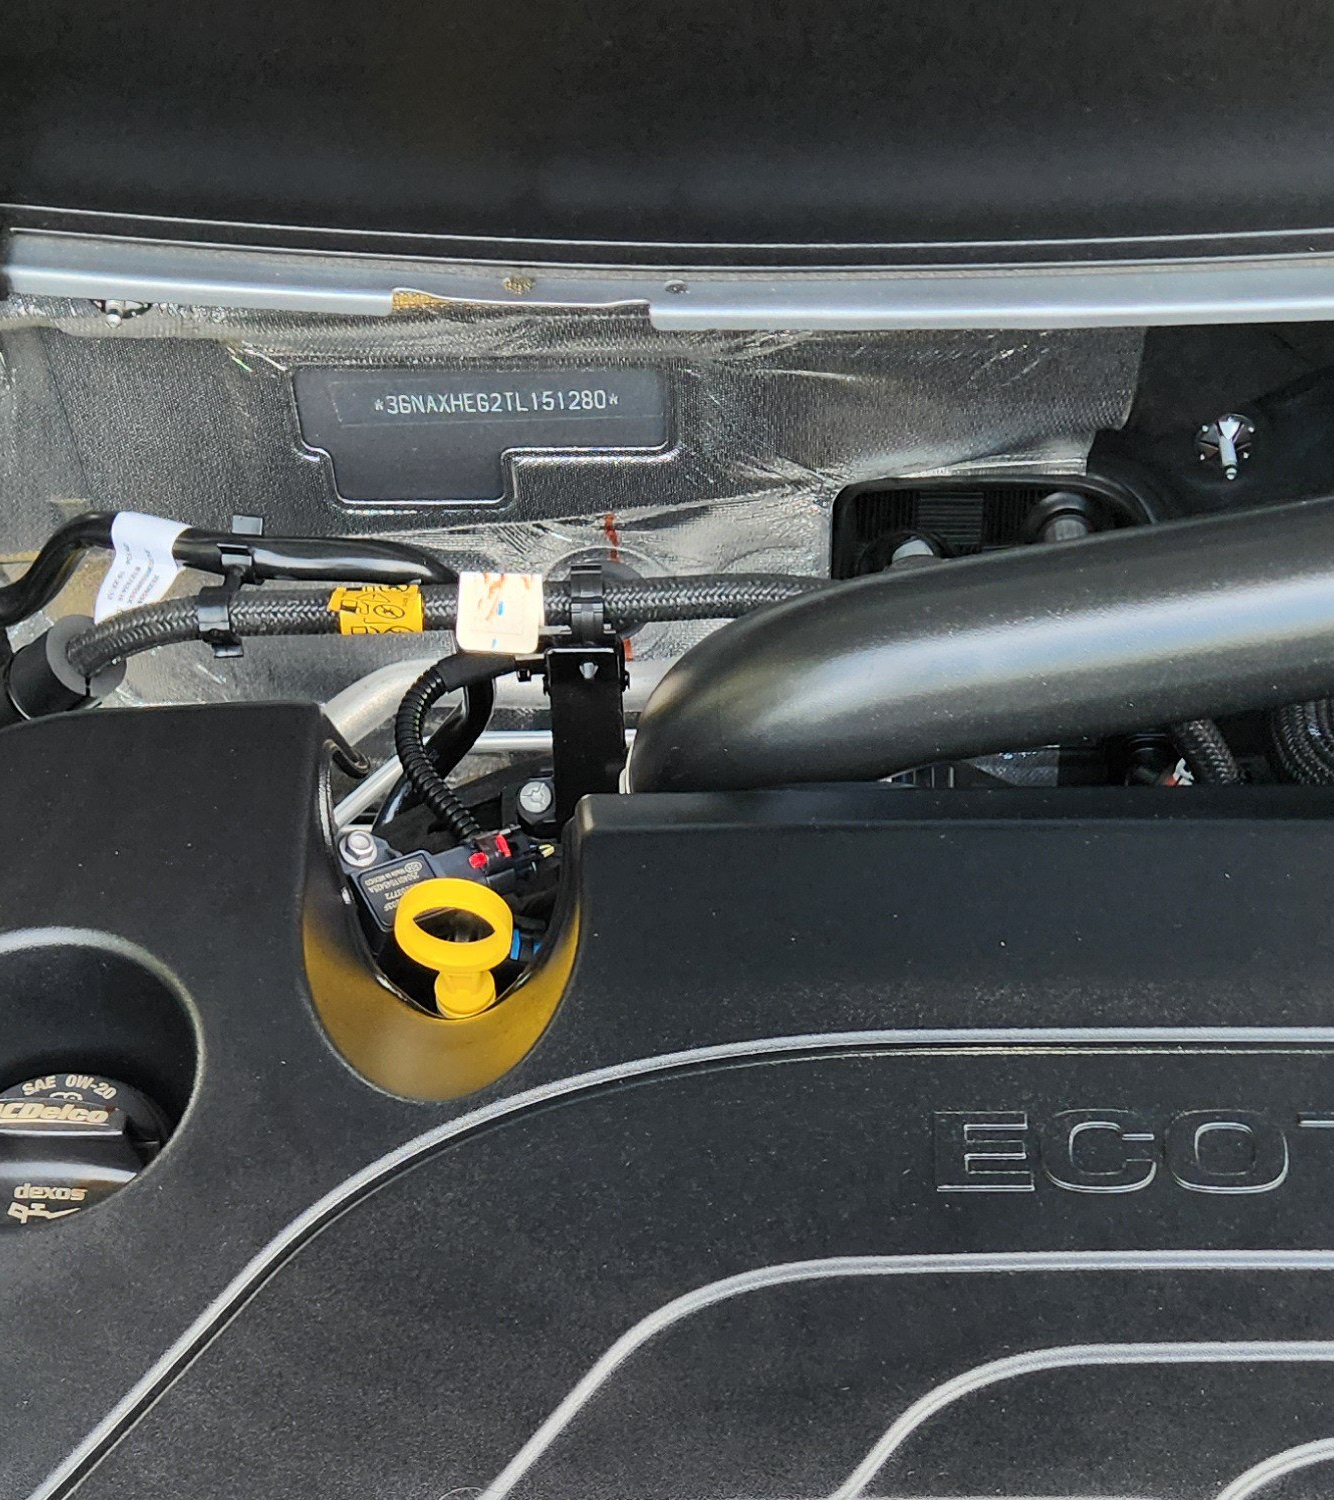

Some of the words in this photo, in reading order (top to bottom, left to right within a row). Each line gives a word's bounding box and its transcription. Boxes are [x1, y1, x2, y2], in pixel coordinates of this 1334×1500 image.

[22, 1075, 56, 1096] SAE
[65, 1074, 117, 1100] 0W-20
[13, 1183, 88, 1200] dexos
